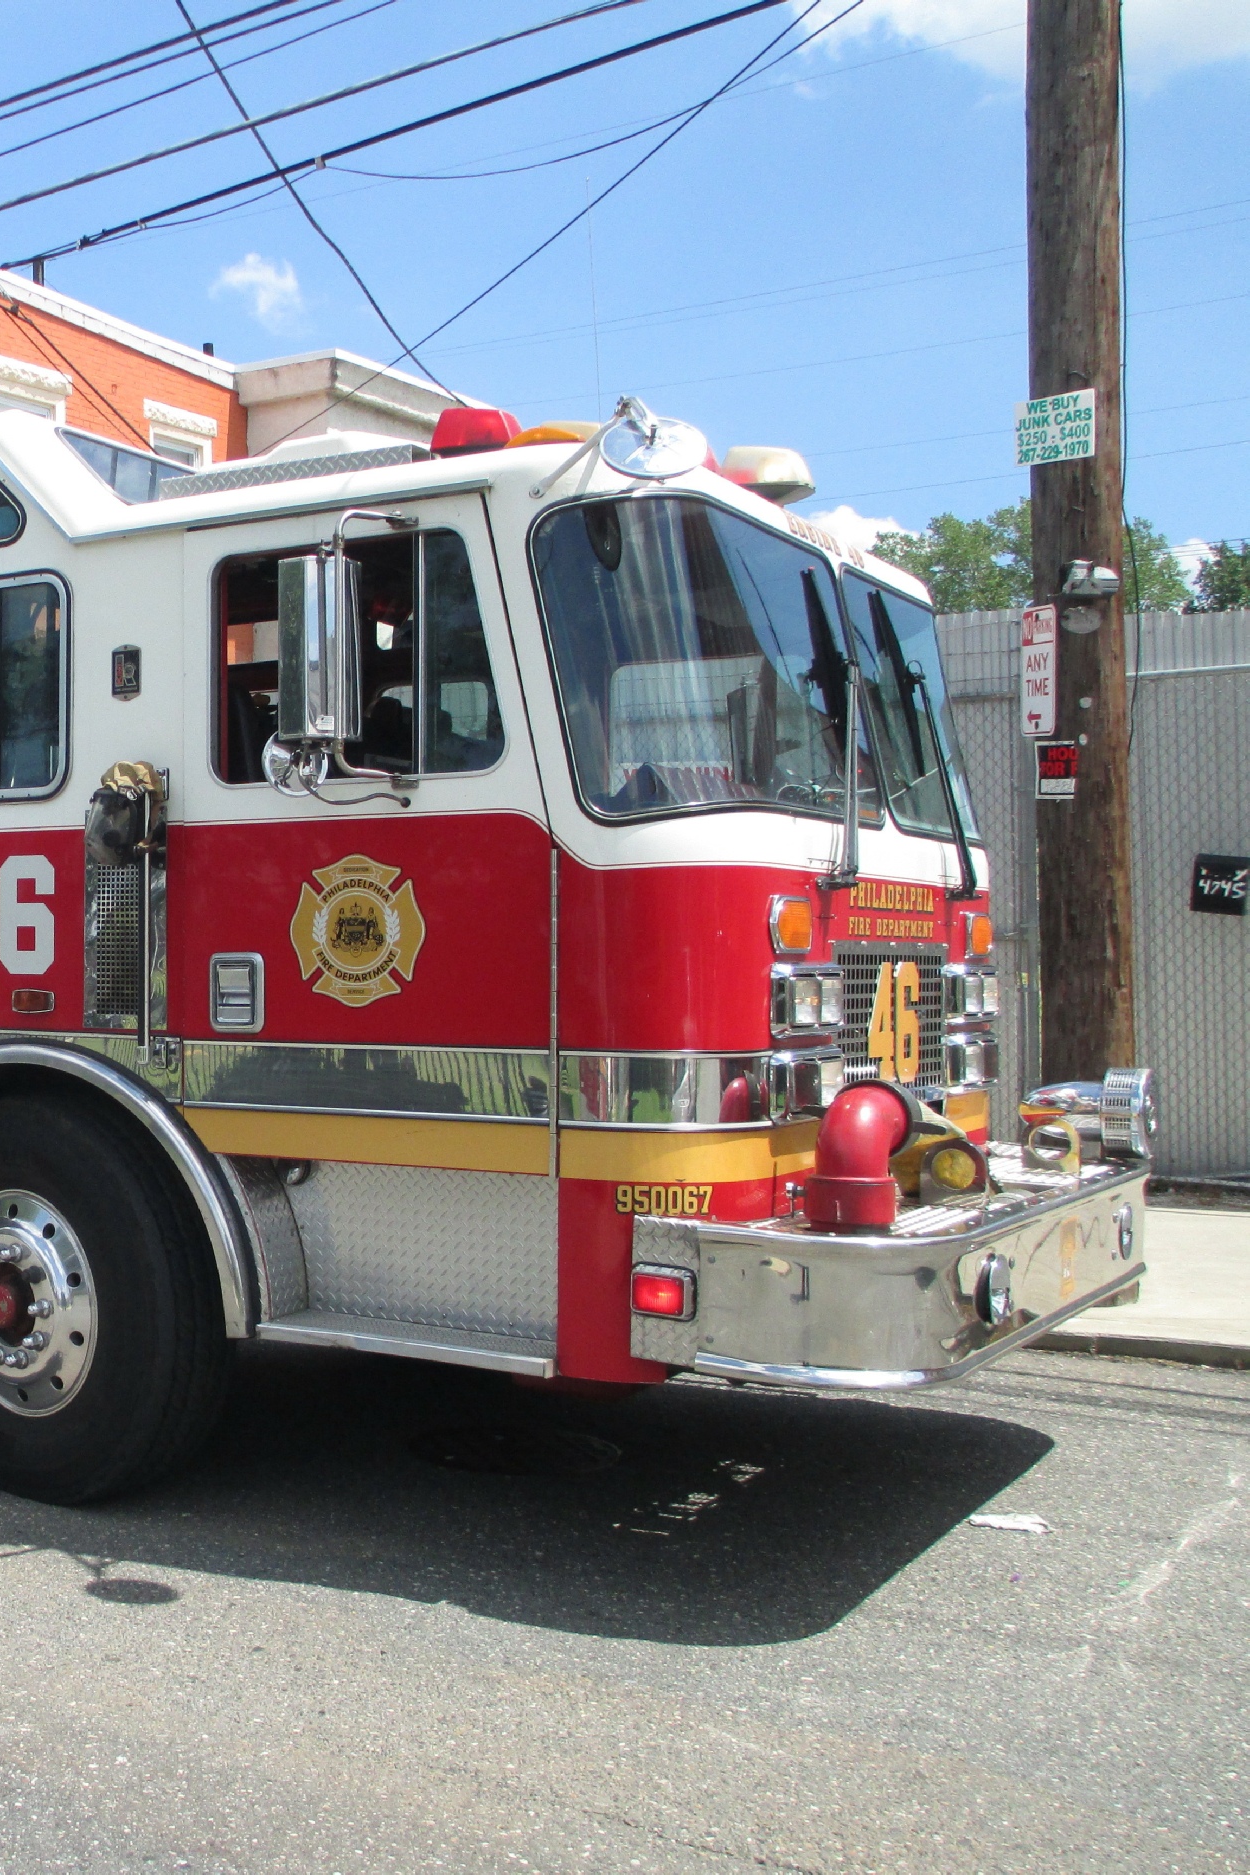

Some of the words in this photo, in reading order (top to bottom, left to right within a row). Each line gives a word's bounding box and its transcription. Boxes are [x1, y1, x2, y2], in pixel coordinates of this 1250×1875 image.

[1026, 400, 1048, 415] WE
[1051, 394, 1080, 411] BUY
[1015, 414, 1051, 432] JUNK
[1054, 407, 1092, 426] CARS
[1017, 430, 1047, 448] $250
[1059, 423, 1090, 442] $400
[1017, 440, 1089, 464] 267-229-1970
[1022, 617, 1033, 641] NO
[1026, 652, 1049, 673] ANY
[1025, 678, 1050, 698] TIME
[1039, 761, 1065, 777] FOR
[322, 879, 391, 903] PHILADELPHIA
[849, 881, 934, 913] PHILADELPHIA
[848, 917, 871, 936] FIRE
[876, 918, 934, 938] DEPARTMENT
[316, 951, 333, 973] FIRE
[335, 951, 397, 983] DEPARTMENT
[868, 961, 920, 1083] 46
[615, 1185, 713, 1216] 950067
